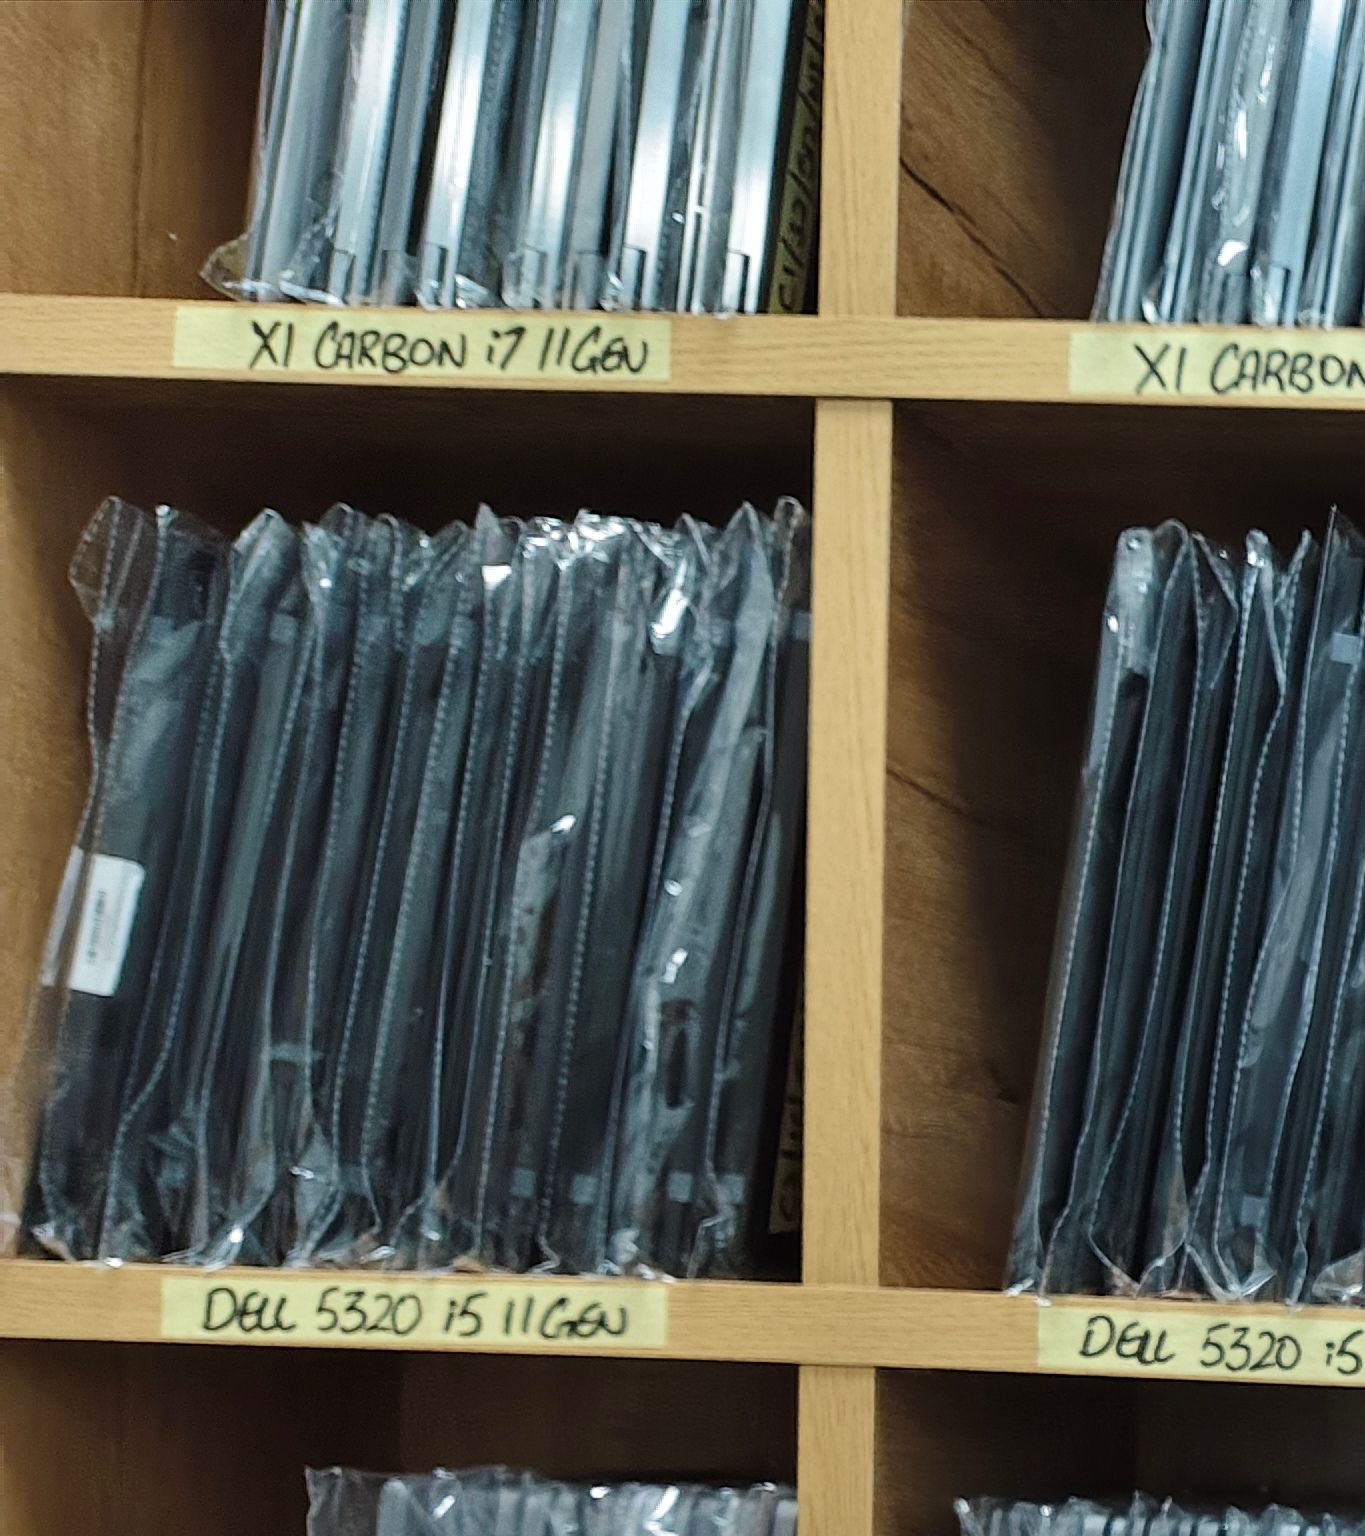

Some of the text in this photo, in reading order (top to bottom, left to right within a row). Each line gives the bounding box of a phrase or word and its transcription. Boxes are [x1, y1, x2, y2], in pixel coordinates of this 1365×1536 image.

[314, 322, 465, 374] CARBON
[202, 1287, 296, 1334] DELL
[316, 1286, 422, 1336] 5320
[443, 1291, 487, 1337] i5
[1079, 1314, 1177, 1366] DELL
[1200, 1323, 1301, 1372] 5320
[1325, 1329, 1364, 1374] i5
